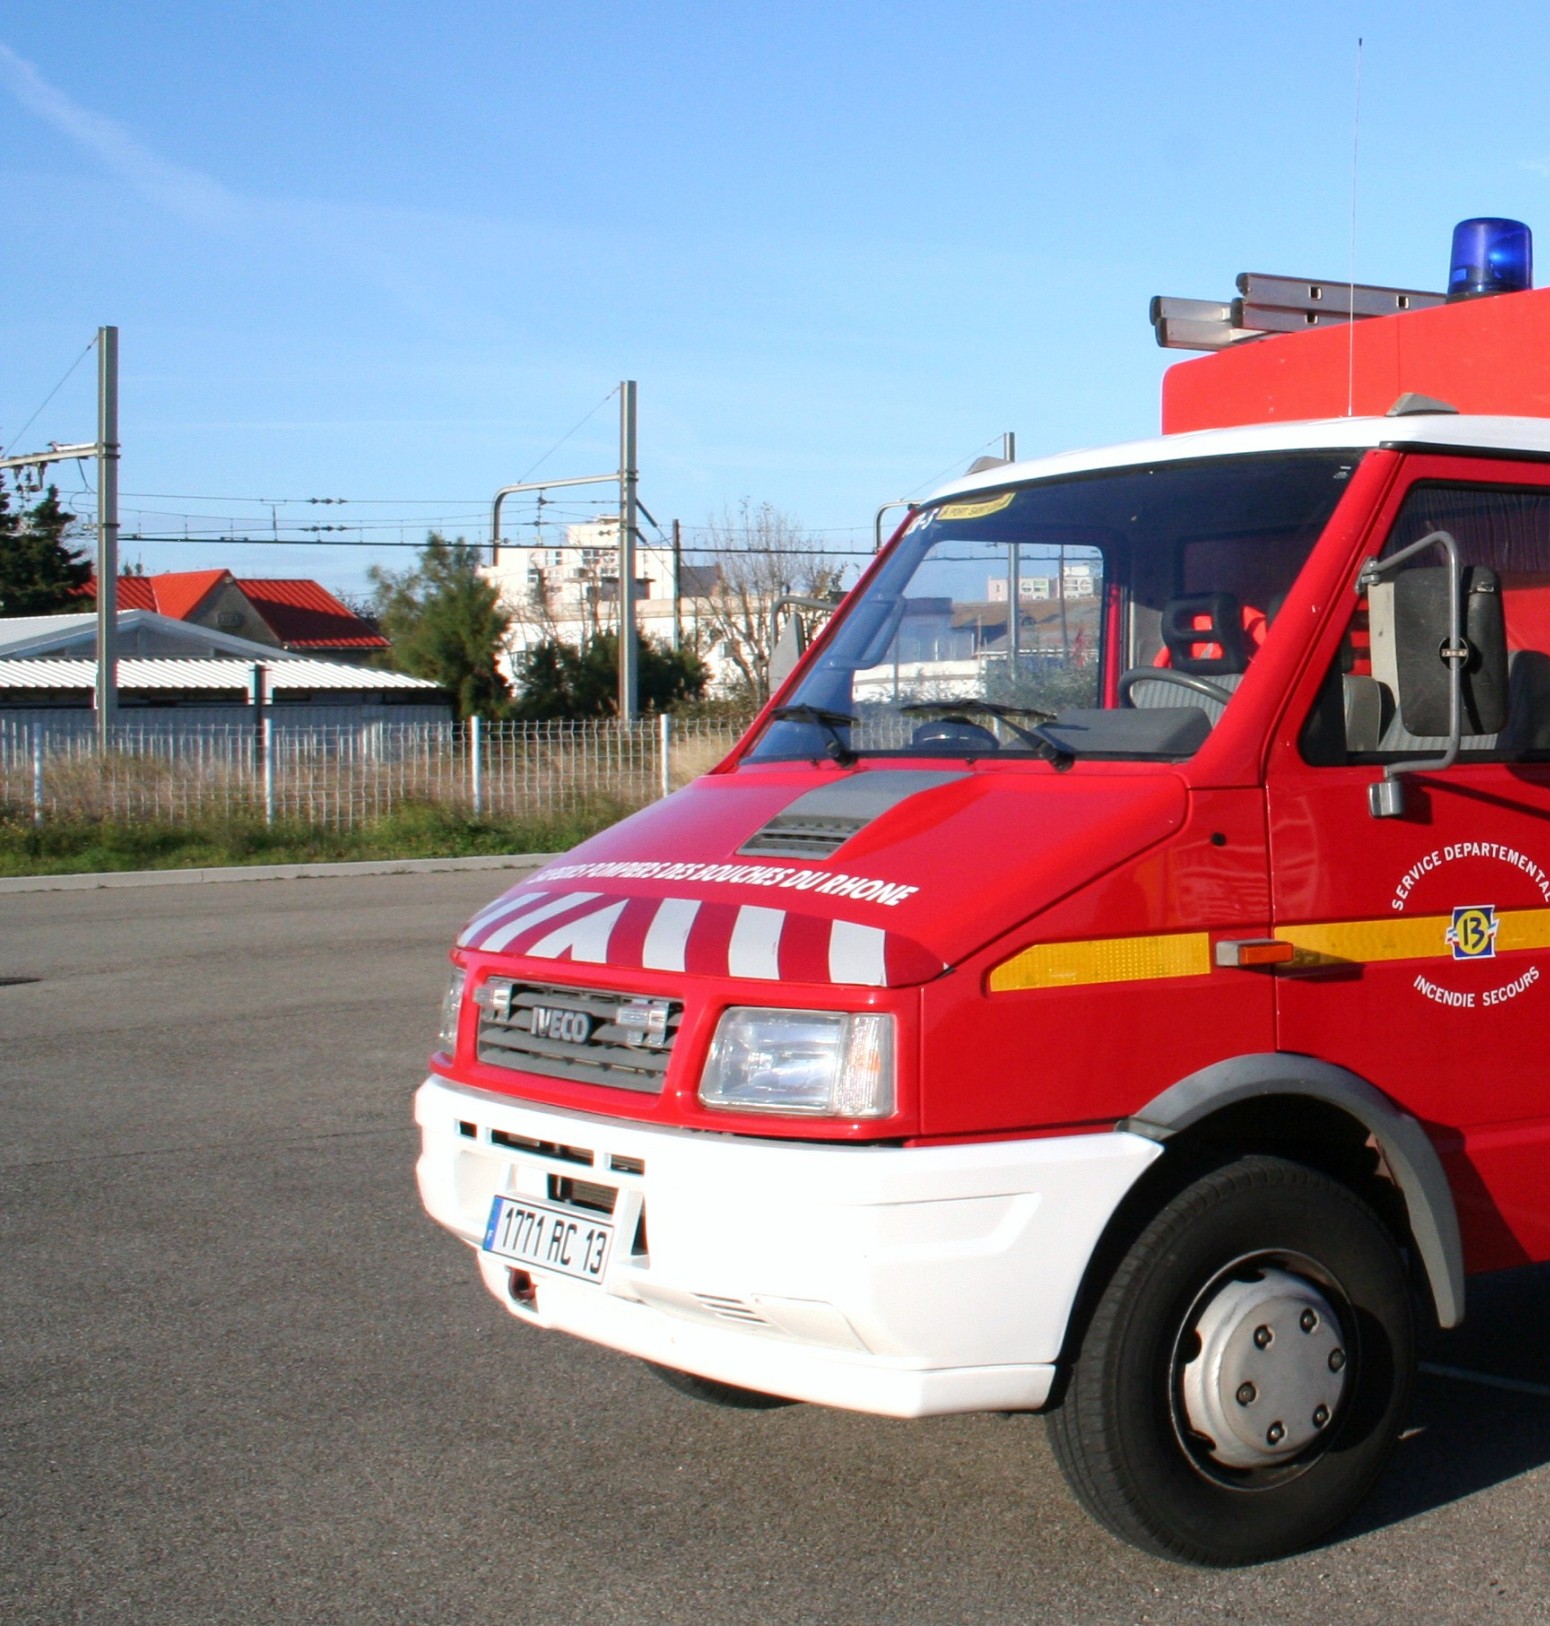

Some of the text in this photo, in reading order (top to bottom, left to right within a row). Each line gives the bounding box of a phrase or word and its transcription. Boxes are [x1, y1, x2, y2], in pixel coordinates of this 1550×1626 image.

[579, 861, 672, 879] POMPIERS
[652, 862, 706, 881] DES
[687, 864, 796, 887] BOUCHES
[778, 869, 832, 890] DU
[814, 874, 920, 906] RHONE
[1391, 850, 1442, 911] SERVICE
[1413, 965, 1540, 1008] INCENDIE SECOURS
[530, 1006, 590, 1043] IVECO
[503, 1206, 545, 1257] 1771
[583, 1228, 607, 1274] 13
